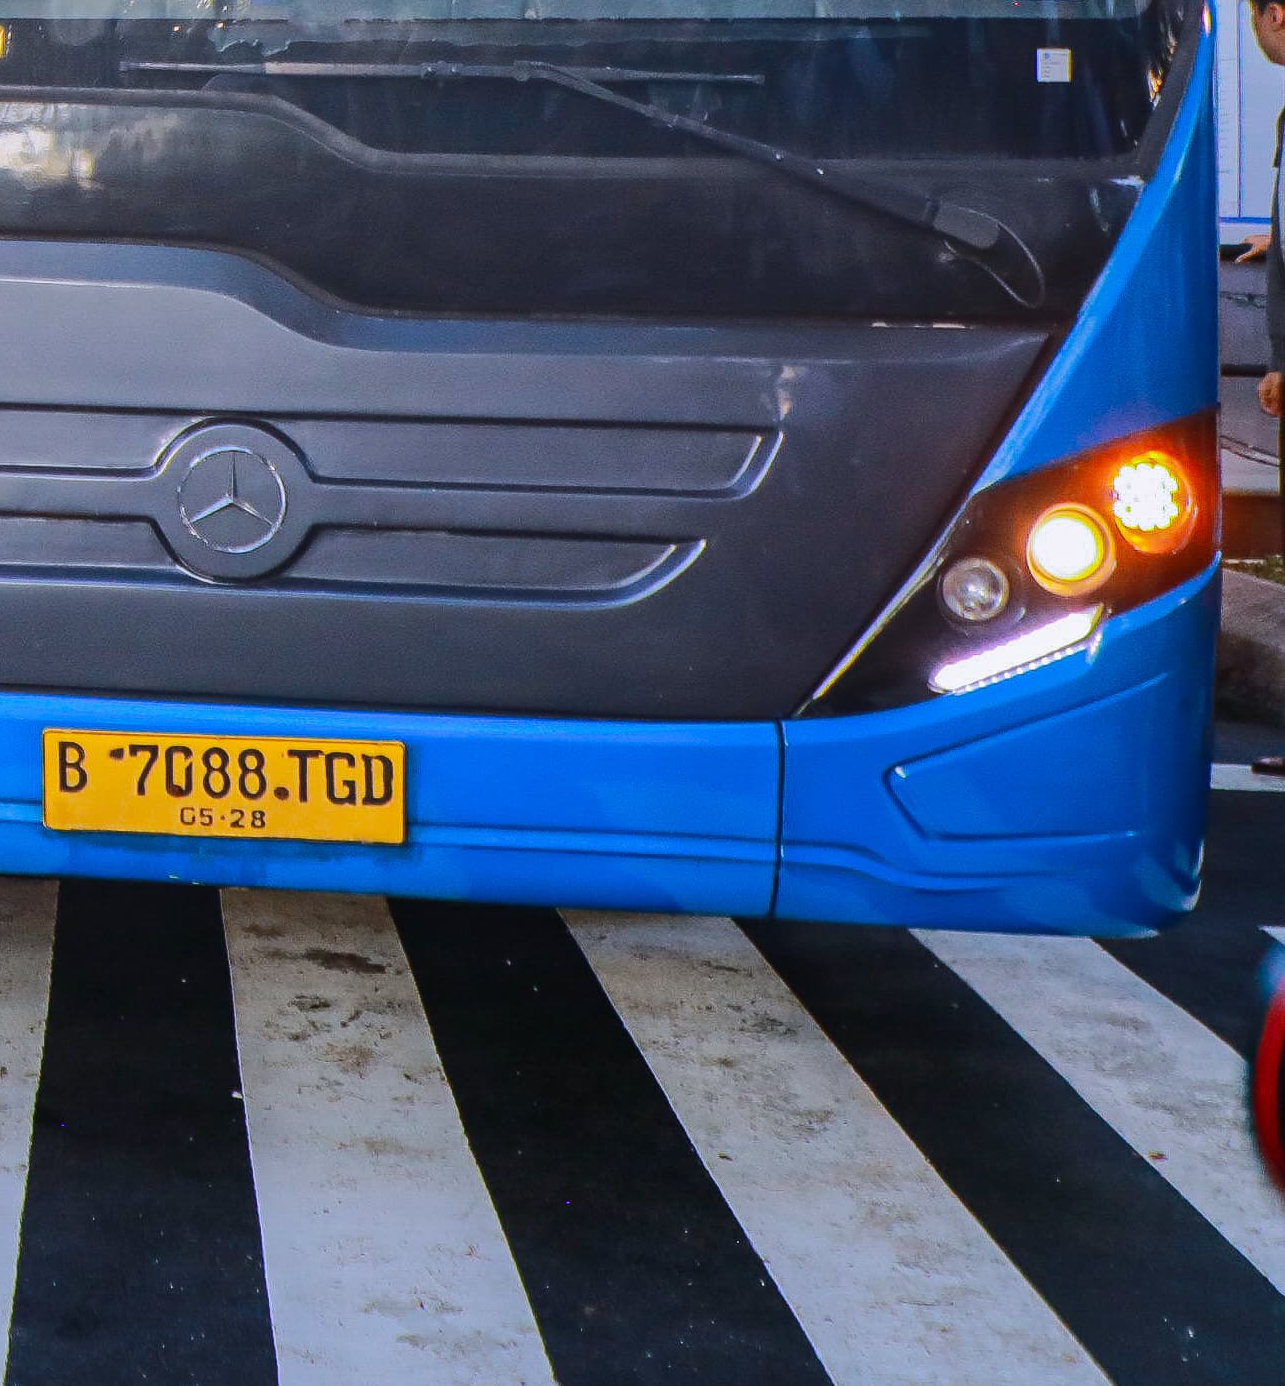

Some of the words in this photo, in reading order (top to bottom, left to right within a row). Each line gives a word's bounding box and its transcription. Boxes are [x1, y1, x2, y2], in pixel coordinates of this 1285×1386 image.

[58, 741, 88, 793] B
[128, 744, 267, 800] 7088
[287, 749, 394, 806] TGD
